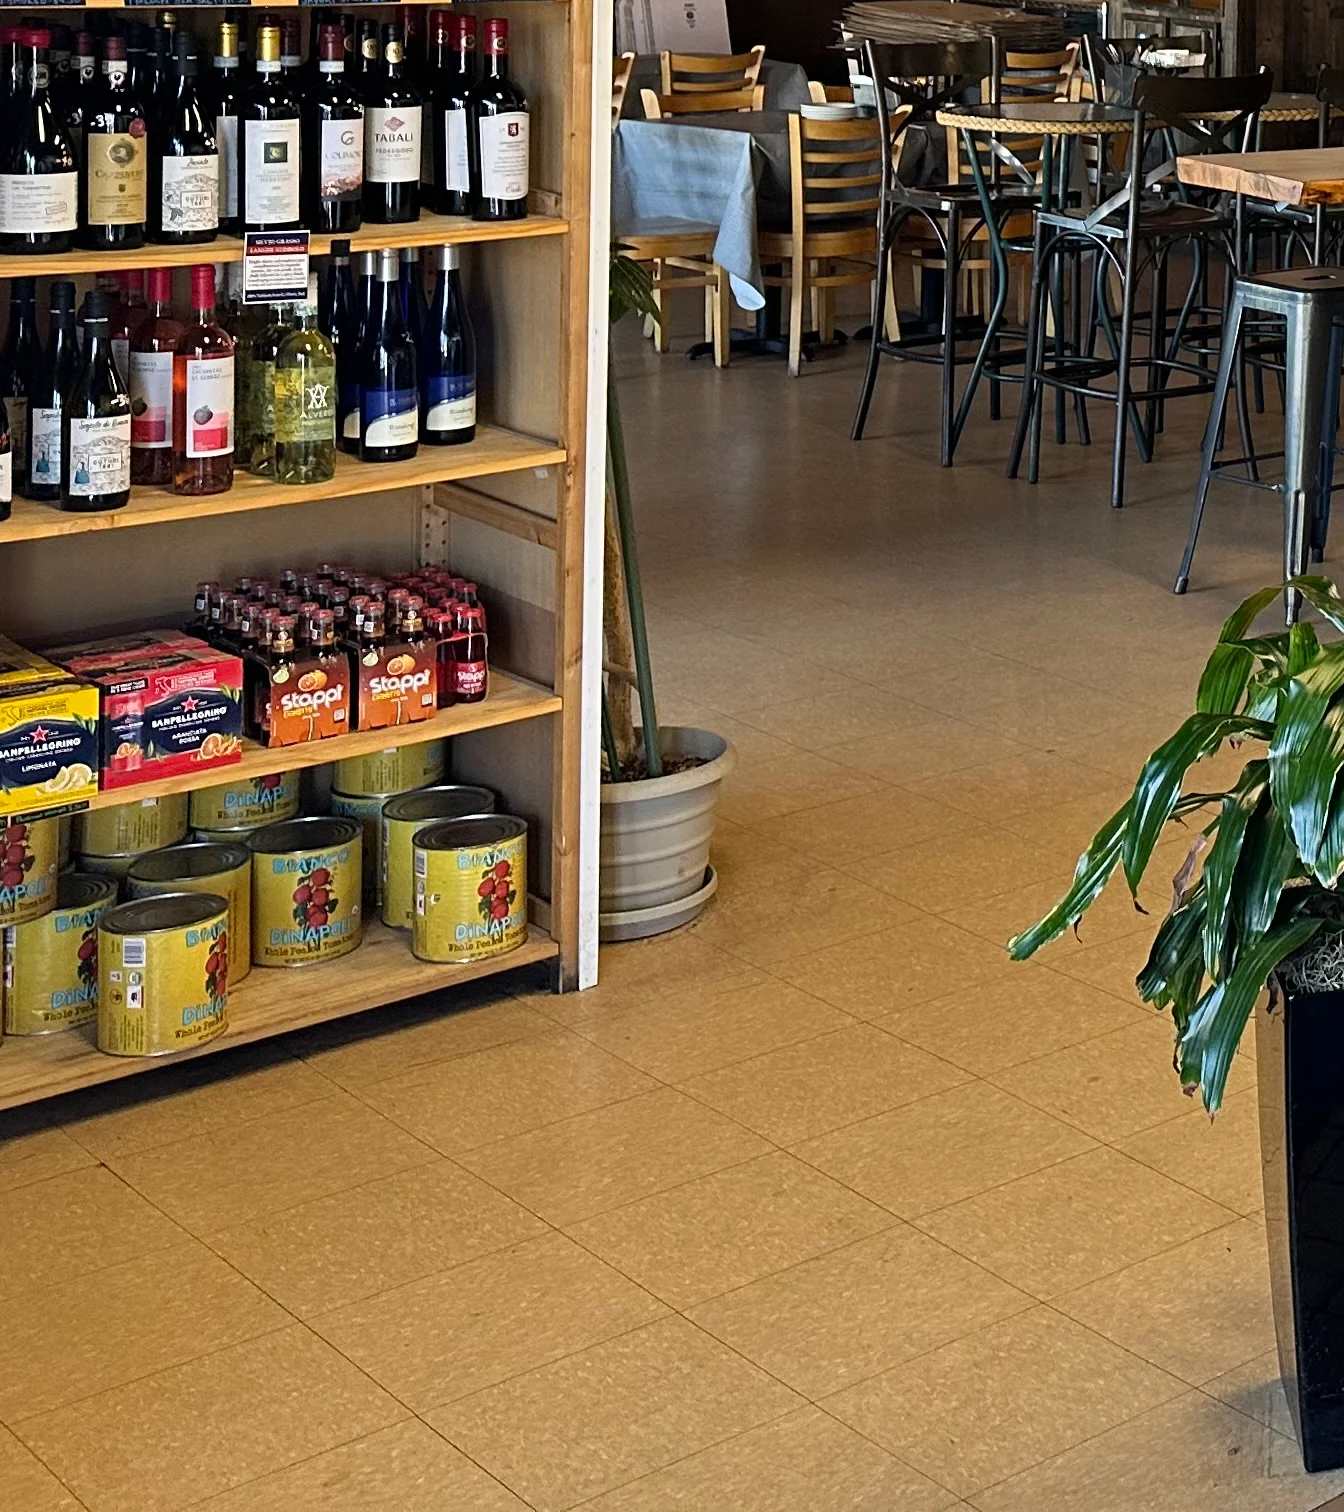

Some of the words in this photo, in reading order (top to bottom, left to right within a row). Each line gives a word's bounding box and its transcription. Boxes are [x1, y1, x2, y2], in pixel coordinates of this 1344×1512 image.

[152, 705, 227, 729] SANPELLEGRINO
[272, 847, 350, 875] BIANCO
[55, 907, 104, 933] BIAN
[186, 919, 229, 948] BIAN
